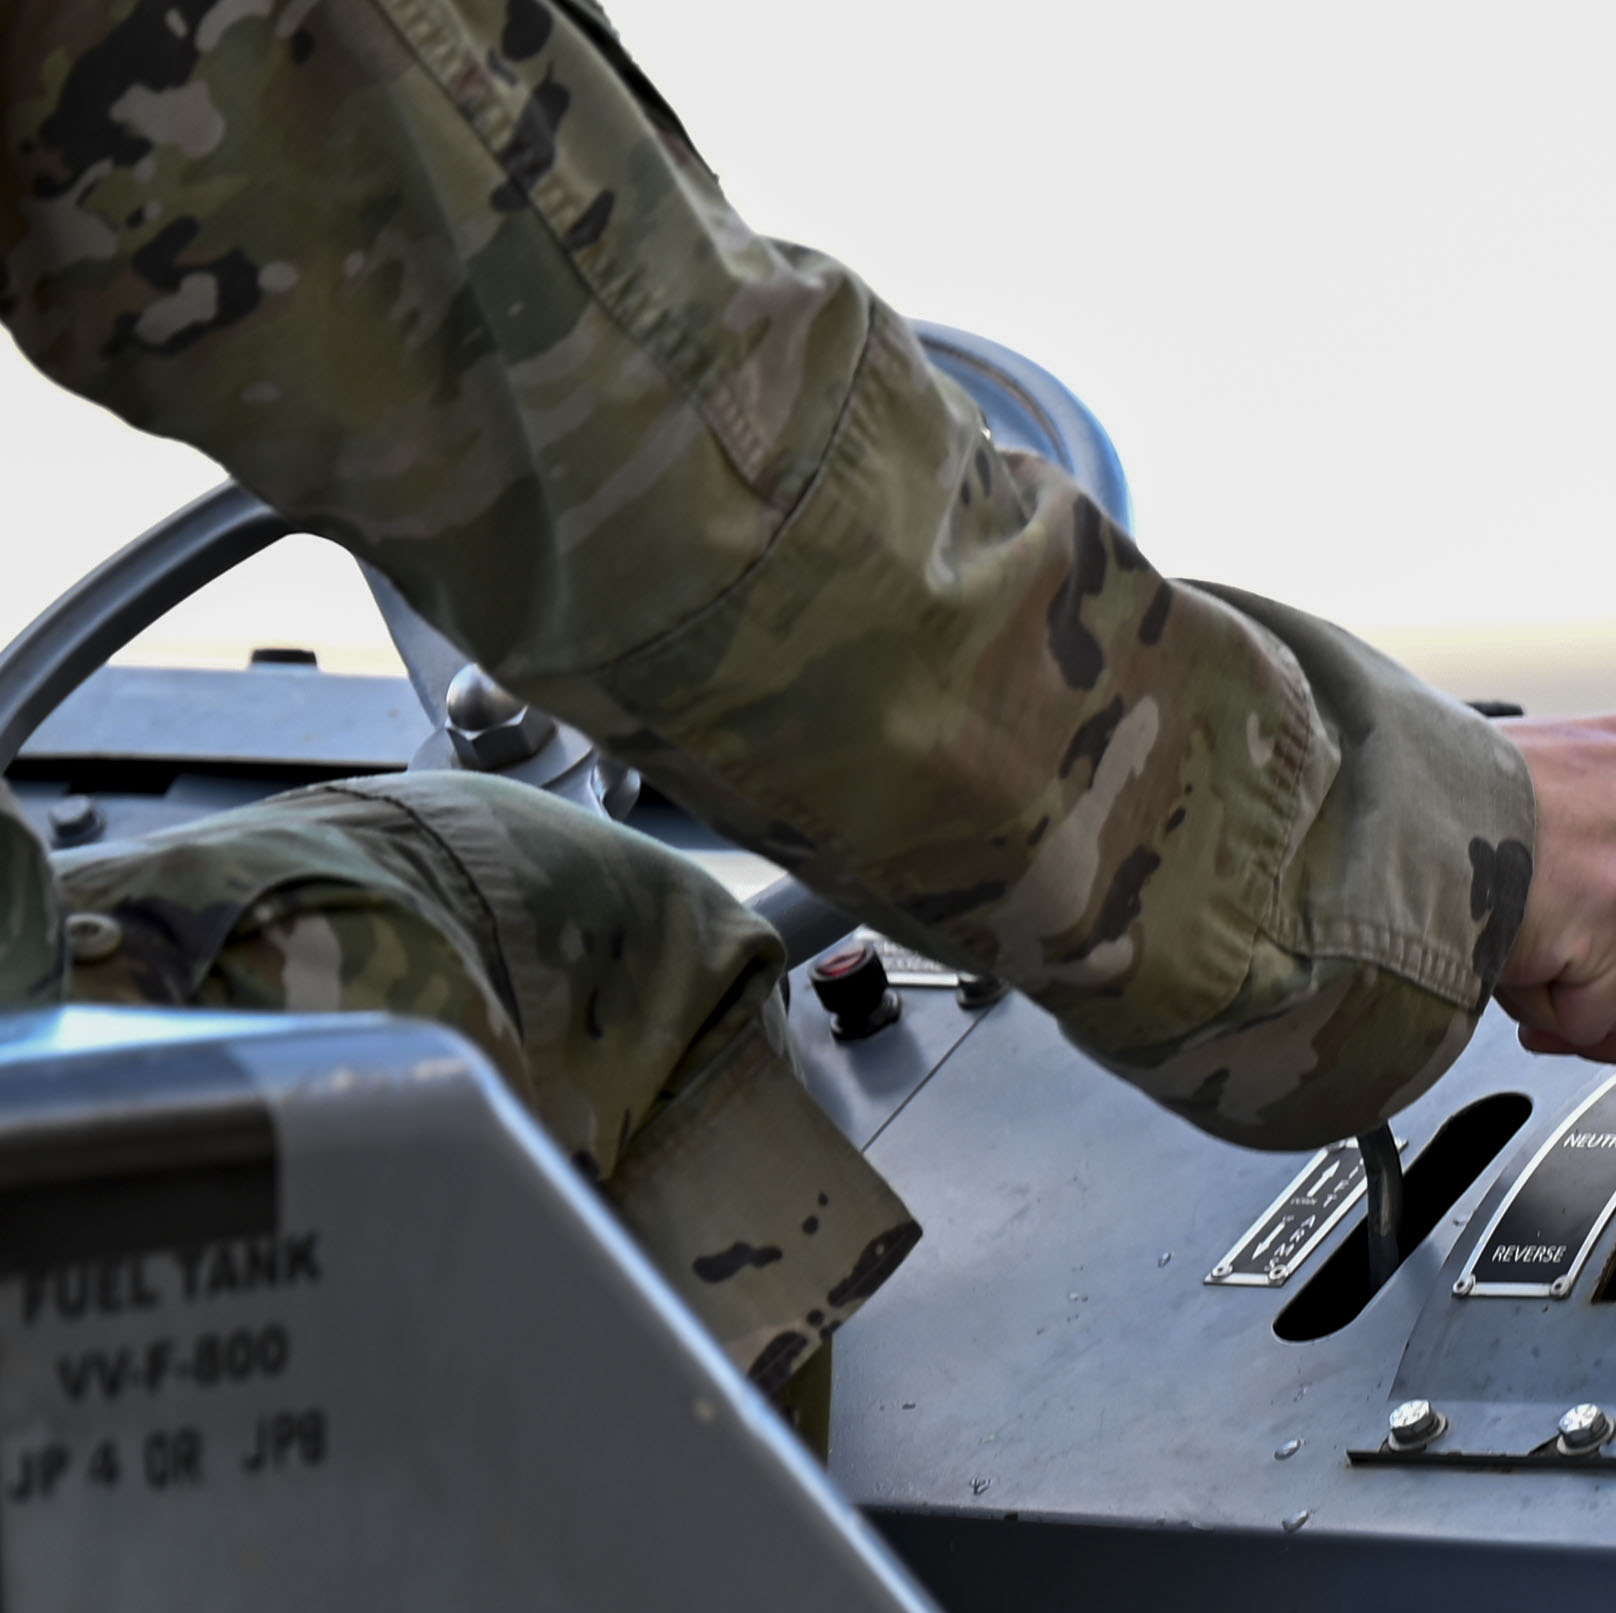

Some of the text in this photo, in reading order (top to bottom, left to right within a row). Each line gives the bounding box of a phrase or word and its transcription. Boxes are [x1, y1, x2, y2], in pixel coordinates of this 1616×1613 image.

[23, 1230, 320, 1325] FUEL TANK
[1491, 1244, 1568, 1265] REVERSE
[8, 1441, 73, 1504] JP
[86, 1435, 122, 1490] 4
[142, 1426, 205, 1492] OR
